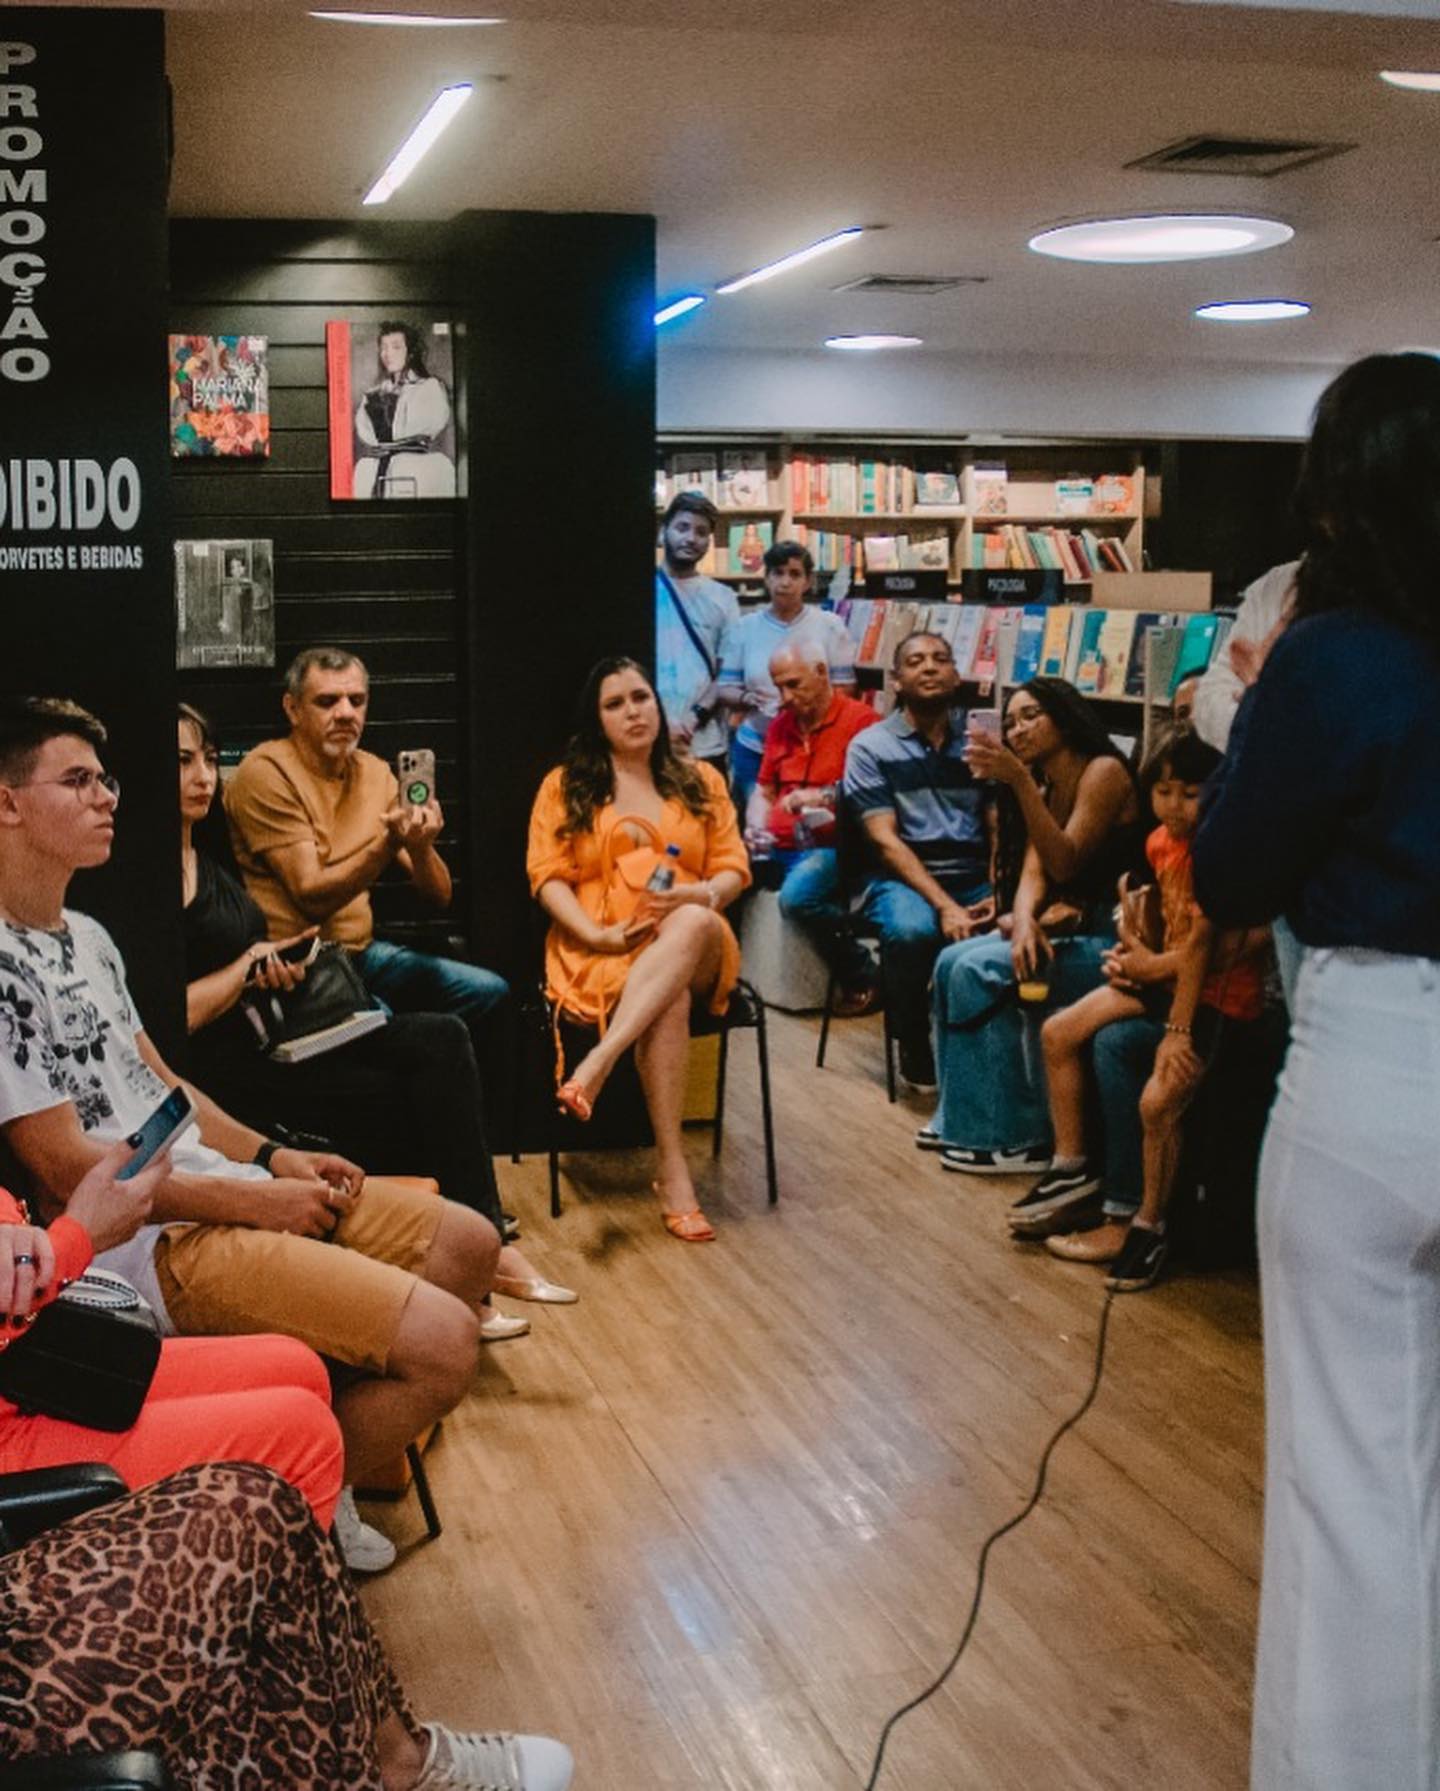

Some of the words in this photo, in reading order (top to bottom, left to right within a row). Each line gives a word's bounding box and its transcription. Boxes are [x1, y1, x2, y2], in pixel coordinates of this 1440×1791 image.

[0, 41, 50, 382] PROMOÇÃO
[0, 457, 141, 531] IBIDO
[67, 547, 77, 570] E
[81, 547, 143, 569] BEBIDAS
